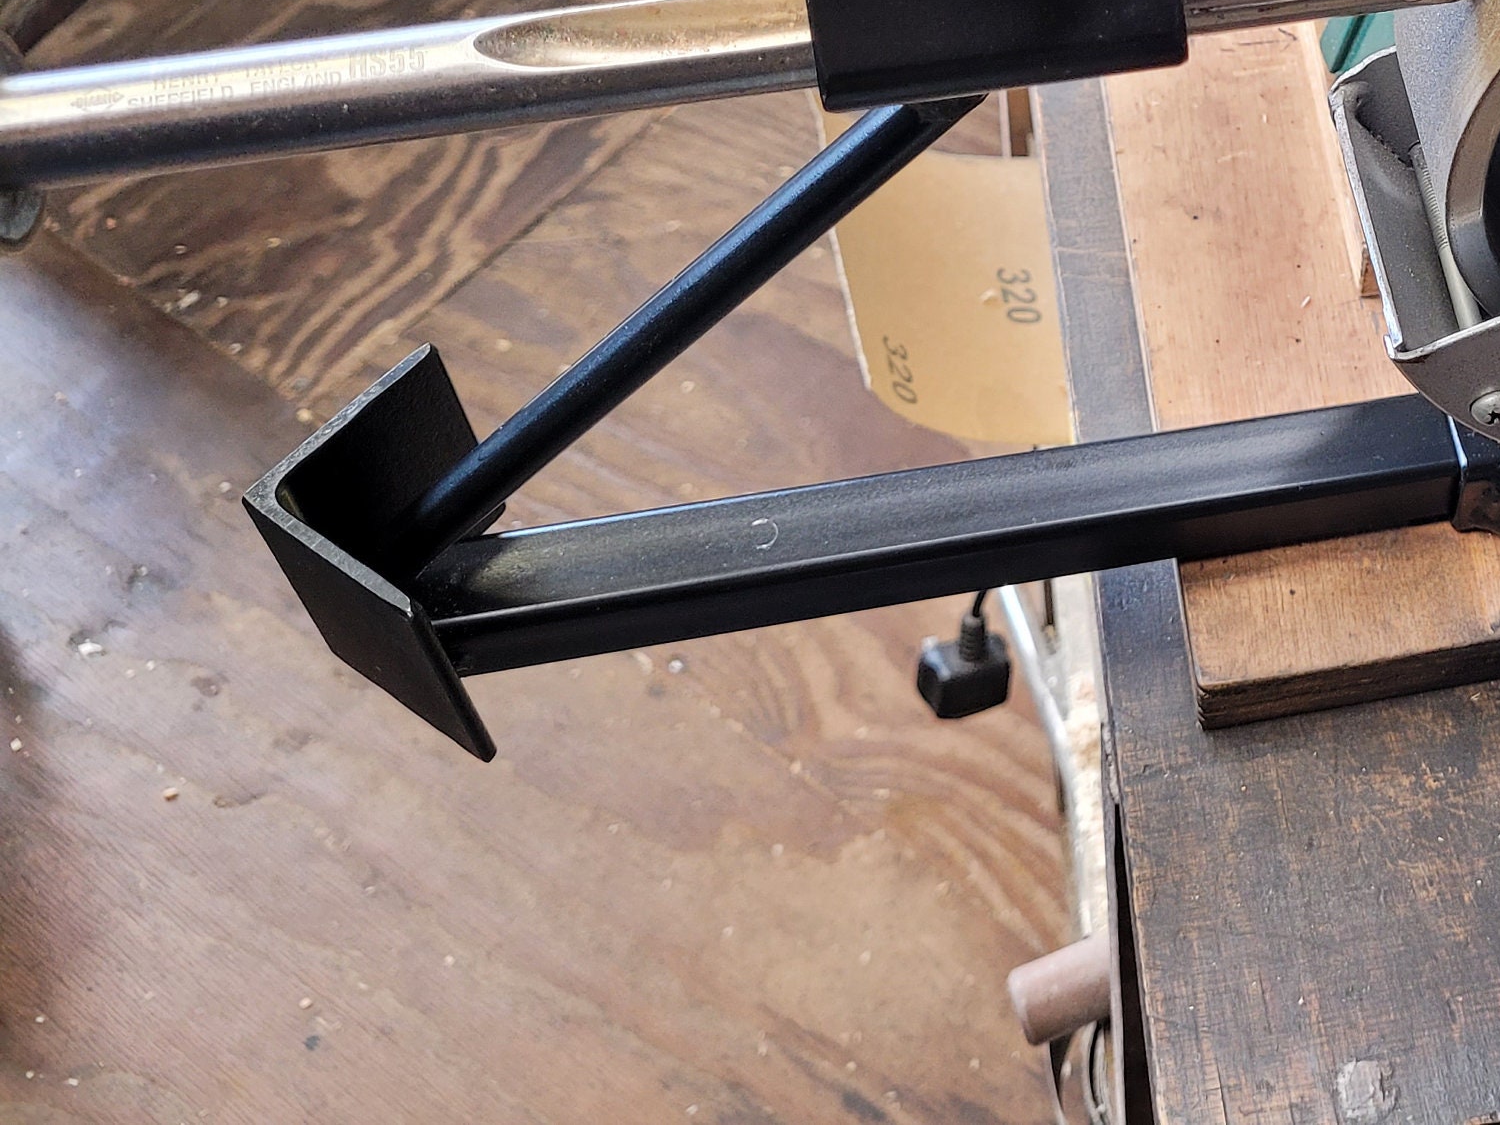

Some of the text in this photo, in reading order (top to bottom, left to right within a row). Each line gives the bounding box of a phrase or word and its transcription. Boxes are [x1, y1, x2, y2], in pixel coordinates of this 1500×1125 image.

[249, 71, 343, 97] ENGLAND
[348, 46, 426, 80] HS55
[996, 268, 1042, 324] 320
[882, 335, 918, 404] 320
